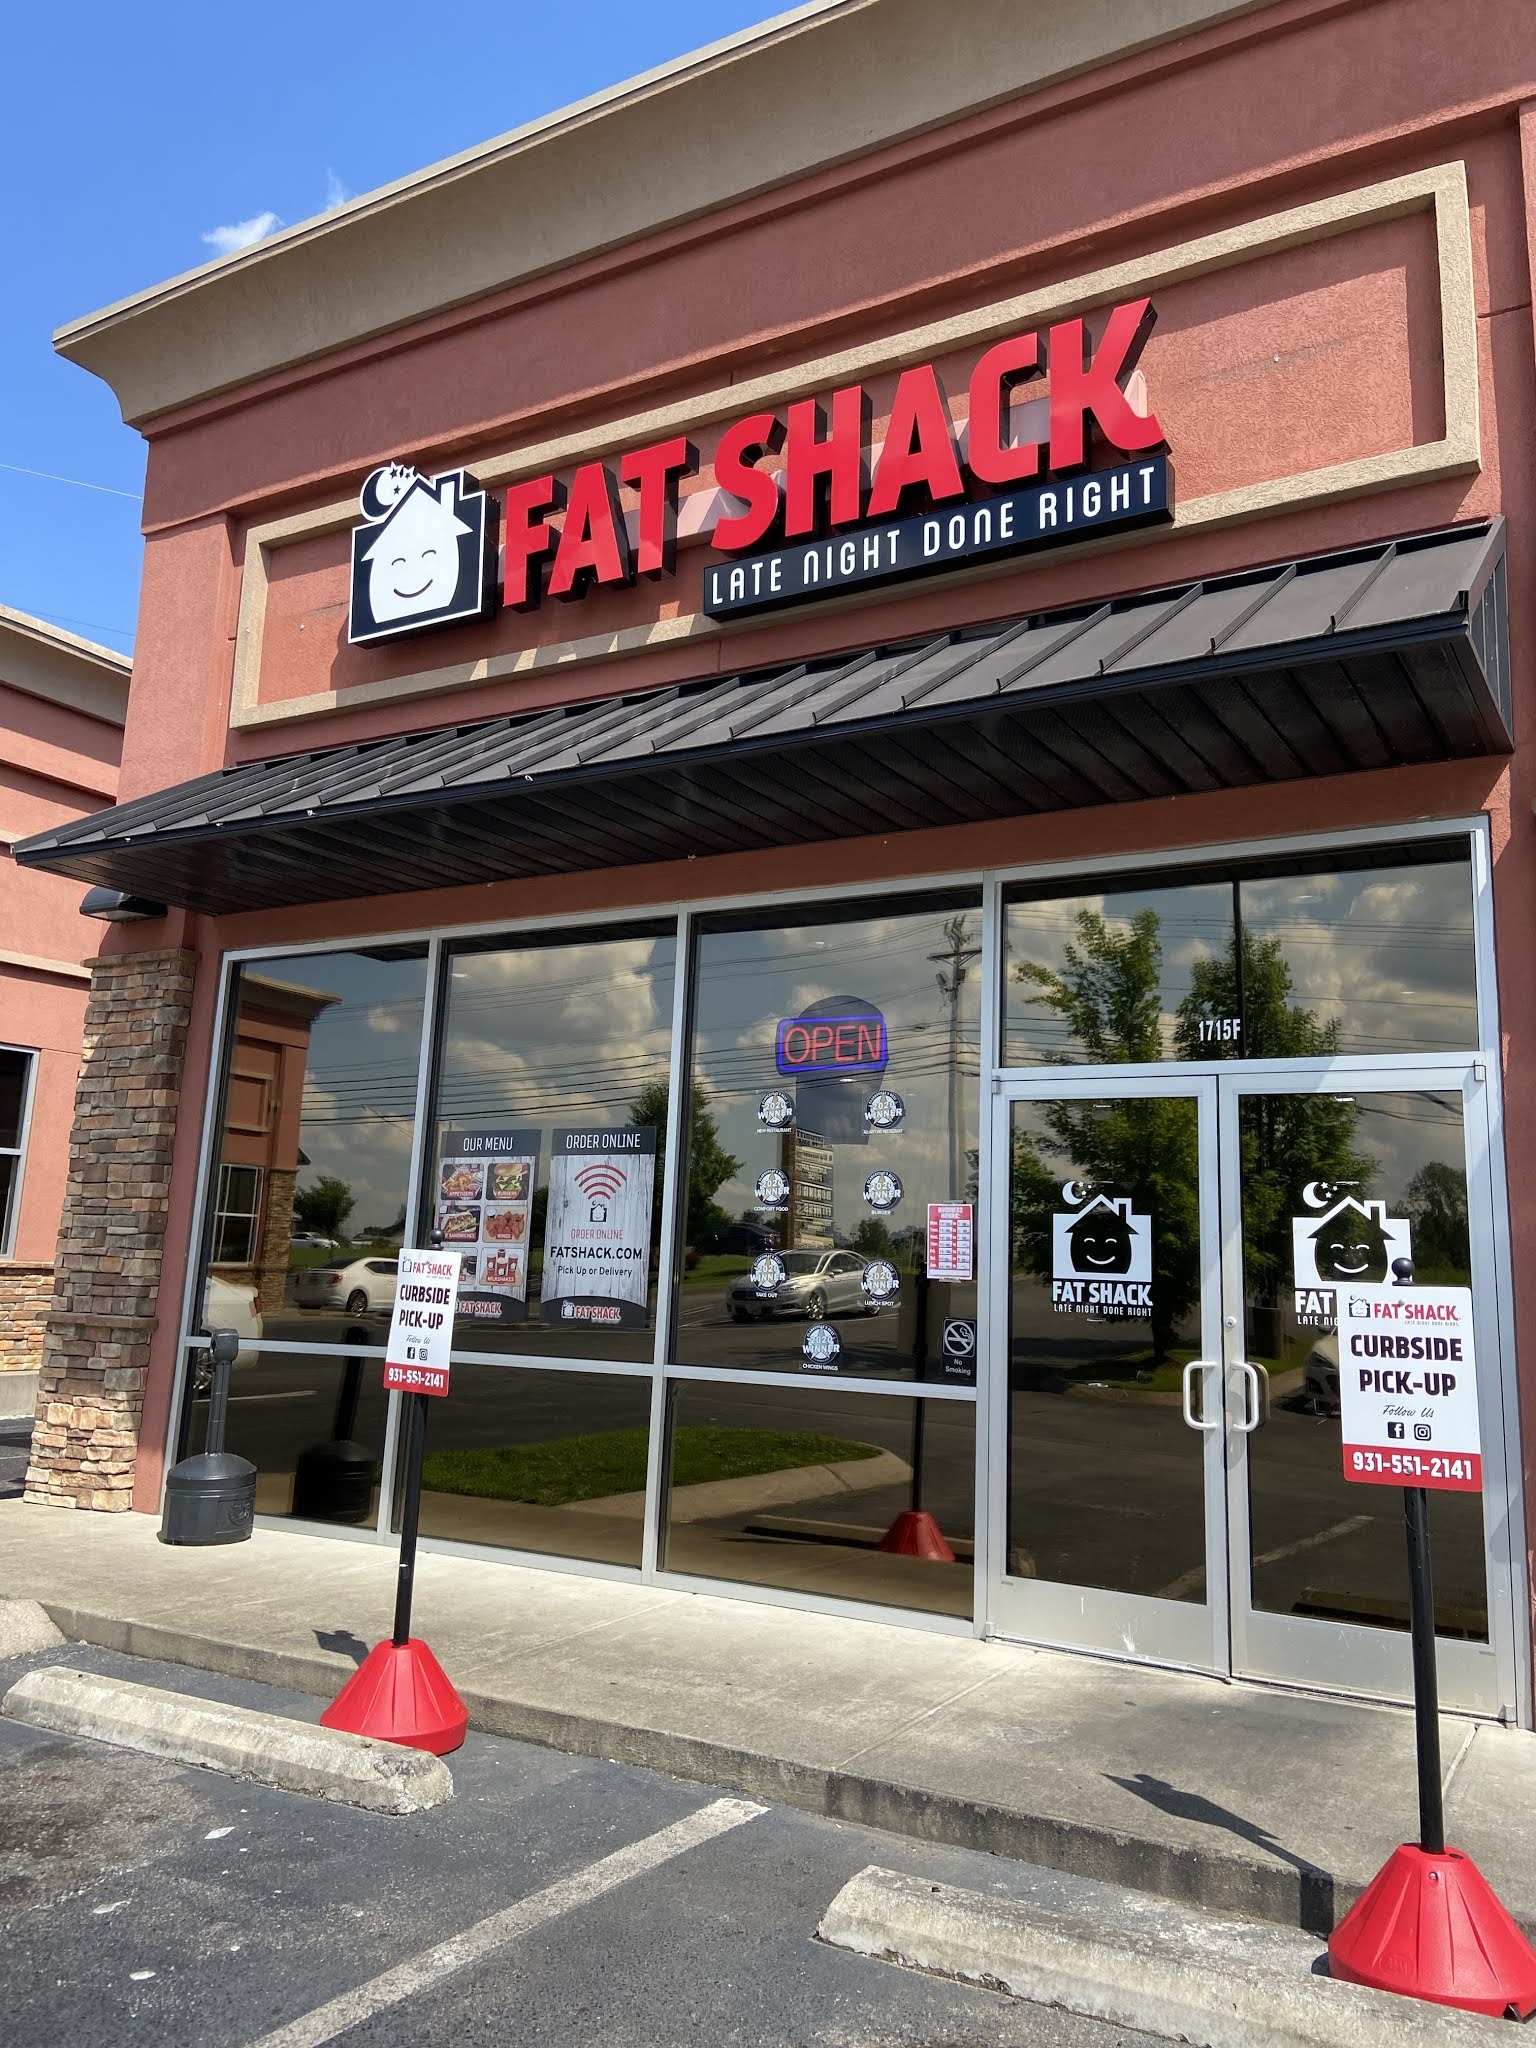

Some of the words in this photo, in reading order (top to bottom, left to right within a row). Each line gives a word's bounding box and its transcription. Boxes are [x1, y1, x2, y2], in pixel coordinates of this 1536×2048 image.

[503, 438, 690, 608] FAT
[711, 298, 1164, 550] SHACK
[711, 563, 783, 605] LATE
[802, 529, 901, 586] NIGHT
[923, 506, 1015, 557] DONE
[1039, 466, 1156, 528] RIGHT
[1199, 1019, 1240, 1041] 1715F
[784, 1025, 881, 1063] OPEN
[766, 1102, 786, 1110] 2020
[873, 1101, 895, 1110] 2020
[758, 1108, 792, 1119] WINNER
[865, 1108, 902, 1120] WINNER
[463, 1138, 483, 1151] OUR
[485, 1137, 513, 1150] MENU
[566, 1134, 600, 1149] ORDER
[602, 1133, 641, 1148] ONLINE
[762, 1180, 783, 1188] 2020
[871, 1182, 893, 1190] 2020
[754, 1187, 790, 1198] WINNER
[863, 1189, 901, 1200] WINNER
[571, 1229, 595, 1239] ORDER
[596, 1229, 623, 1239] ONLINE
[550, 1247, 642, 1259] FATSHACK.COM
[412, 1262, 425, 1272] FAT
[427, 1262, 452, 1276] SHACK
[558, 1266, 574, 1274] Pick
[576, 1266, 587, 1276] Up
[599, 1267, 633, 1277] Delivery
[758, 1265, 779, 1273] 2020
[750, 1272, 786, 1283] WINNER
[869, 1272, 892, 1280] 2020
[861, 1280, 899, 1291] WINNER
[400, 1284, 451, 1305] CURBSIDE
[1053, 1281, 1085, 1302] FAT
[1088, 1283, 1154, 1306] SHACK
[461, 1302, 474, 1313] FAT
[475, 1302, 501, 1314] SHACK
[1295, 1291, 1333, 1314] FAT
[576, 1307, 591, 1319] FAT
[591, 1307, 620, 1320] SHACK
[1054, 1304, 1072, 1312] LATE
[1076, 1305, 1099, 1314] NIGHT
[1103, 1306, 1123, 1315] DONE
[1128, 1307, 1152, 1317] RIGHT
[1374, 1303, 1399, 1319] FAT
[1405, 1304, 1459, 1321] SHACK
[398, 1309, 444, 1330] PICK-UP
[1297, 1315, 1319, 1325] LATE
[1323, 1316, 1338, 1326] NIG
[405, 1335, 421, 1345] Follow
[423, 1336, 431, 1345] Us
[811, 1336, 833, 1344] 2020
[802, 1344, 840, 1354] WINNER
[1350, 1334, 1463, 1362] CURBSIDE
[945, 1366, 971, 1376] Smoking
[388, 1367, 444, 1388] 931-551-2141
[1359, 1369, 1456, 1397] PICK-UP
[1382, 1405, 1416, 1417] Follow
[1421, 1408, 1435, 1418] Us
[1352, 1452, 1473, 1480] 931-551-2141
